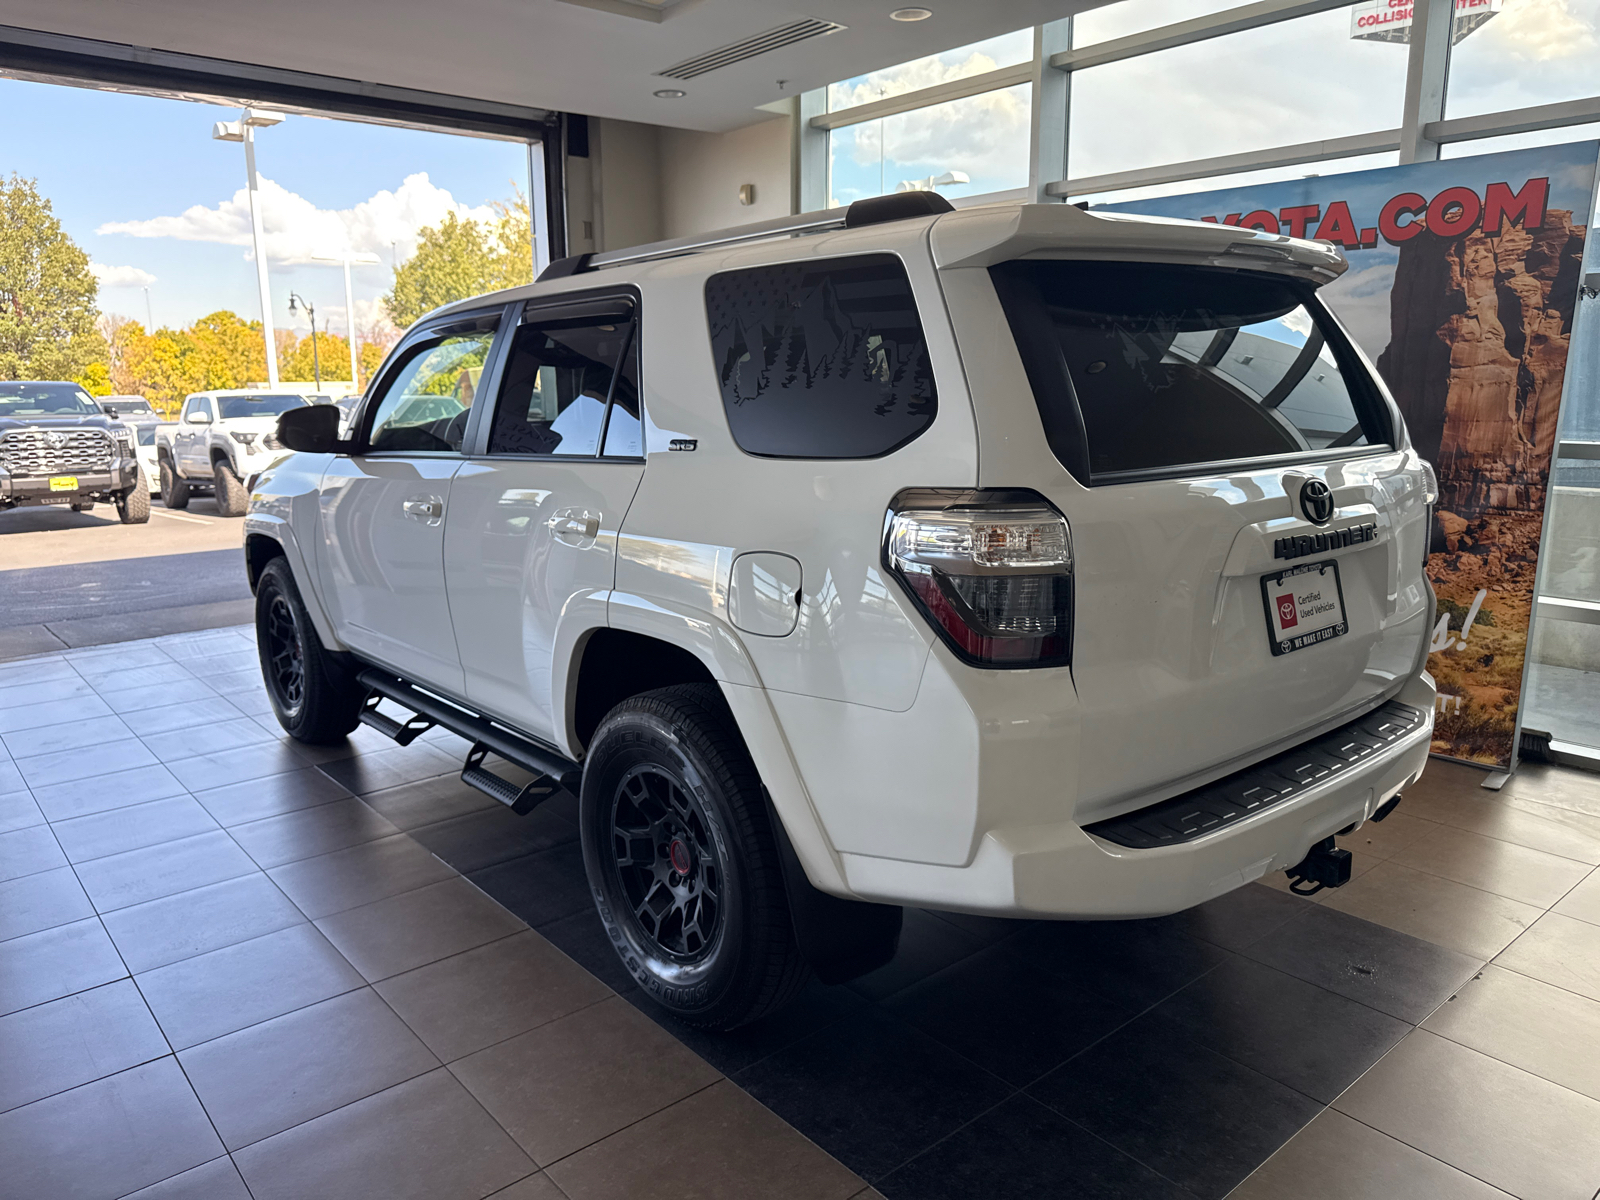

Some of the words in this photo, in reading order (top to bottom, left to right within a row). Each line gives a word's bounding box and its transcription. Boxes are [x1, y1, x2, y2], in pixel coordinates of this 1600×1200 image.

[1298, 591, 1321, 605] Certified
[1300, 608, 1315, 619] Used
[1315, 601, 1336, 614] Vehicles
[1294, 638, 1303, 648] WE
[1303, 632, 1316, 646] MAKE
[1321, 627, 1333, 640] EASY
